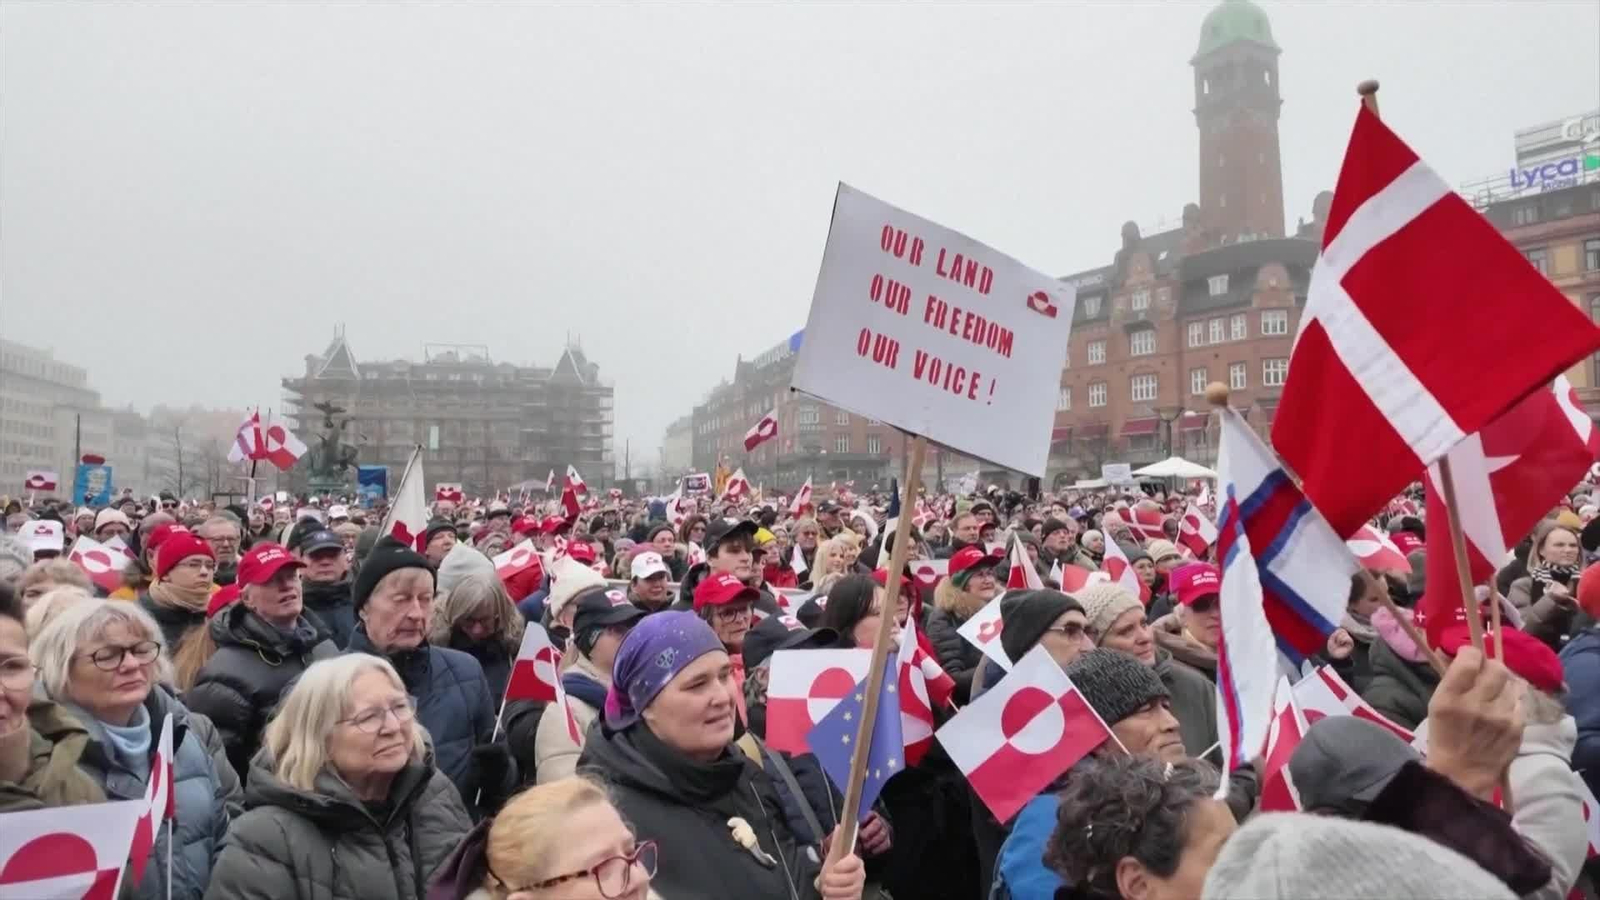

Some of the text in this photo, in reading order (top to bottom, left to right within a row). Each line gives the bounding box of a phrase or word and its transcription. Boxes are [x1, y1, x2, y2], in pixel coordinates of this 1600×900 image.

[1510, 158, 1578, 188] Lyca
[880, 224, 994, 295] OUR LAND
[869, 273, 1014, 358] OUR FREEDOM
[857, 327, 899, 369] OUR
